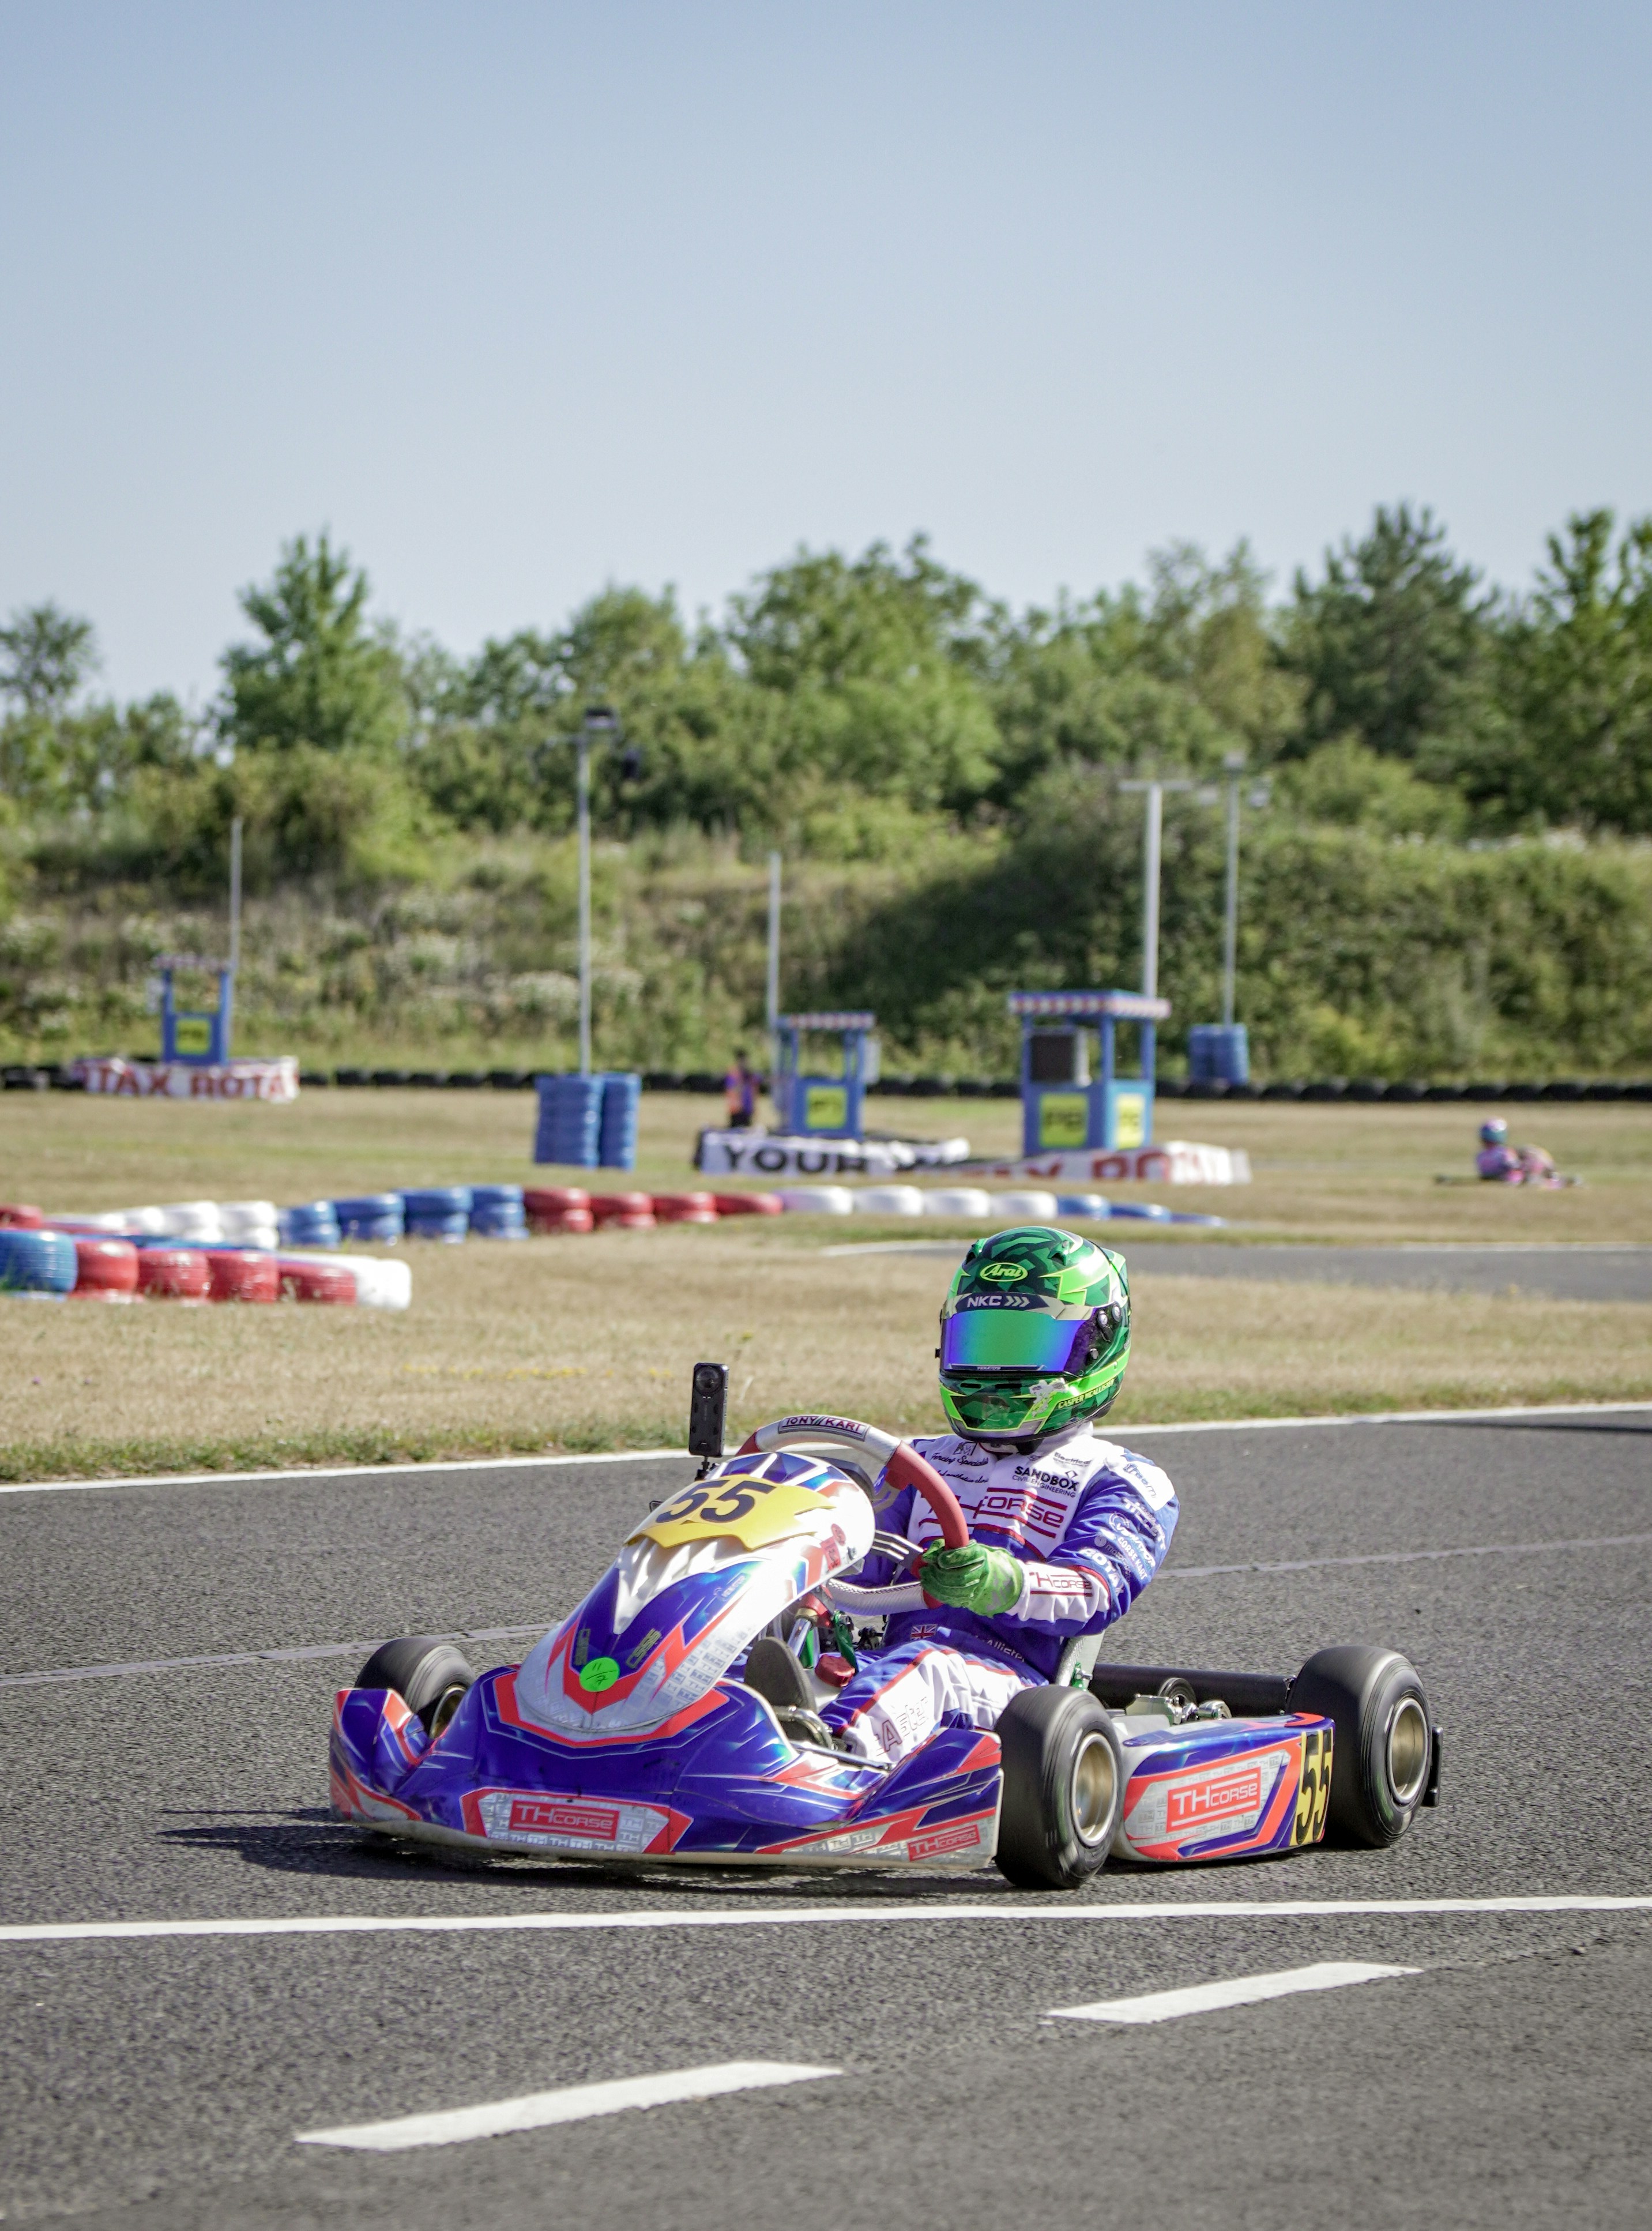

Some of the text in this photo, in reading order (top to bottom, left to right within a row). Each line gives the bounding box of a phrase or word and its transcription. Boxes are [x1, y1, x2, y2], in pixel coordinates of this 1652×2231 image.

[984, 1265, 1021, 1277] Arai
[967, 1296, 1002, 1307] NKC
[1058, 1394, 1084, 1409] CASPER
[1012, 1474, 1077, 1498] CIVIL ENGINEERING
[1014, 1466, 1079, 1491] SANDBOX
[656, 1479, 777, 1523] 55
[1117, 1537, 1148, 1580] CORSE KART
[1296, 1729, 1332, 1845] 55
